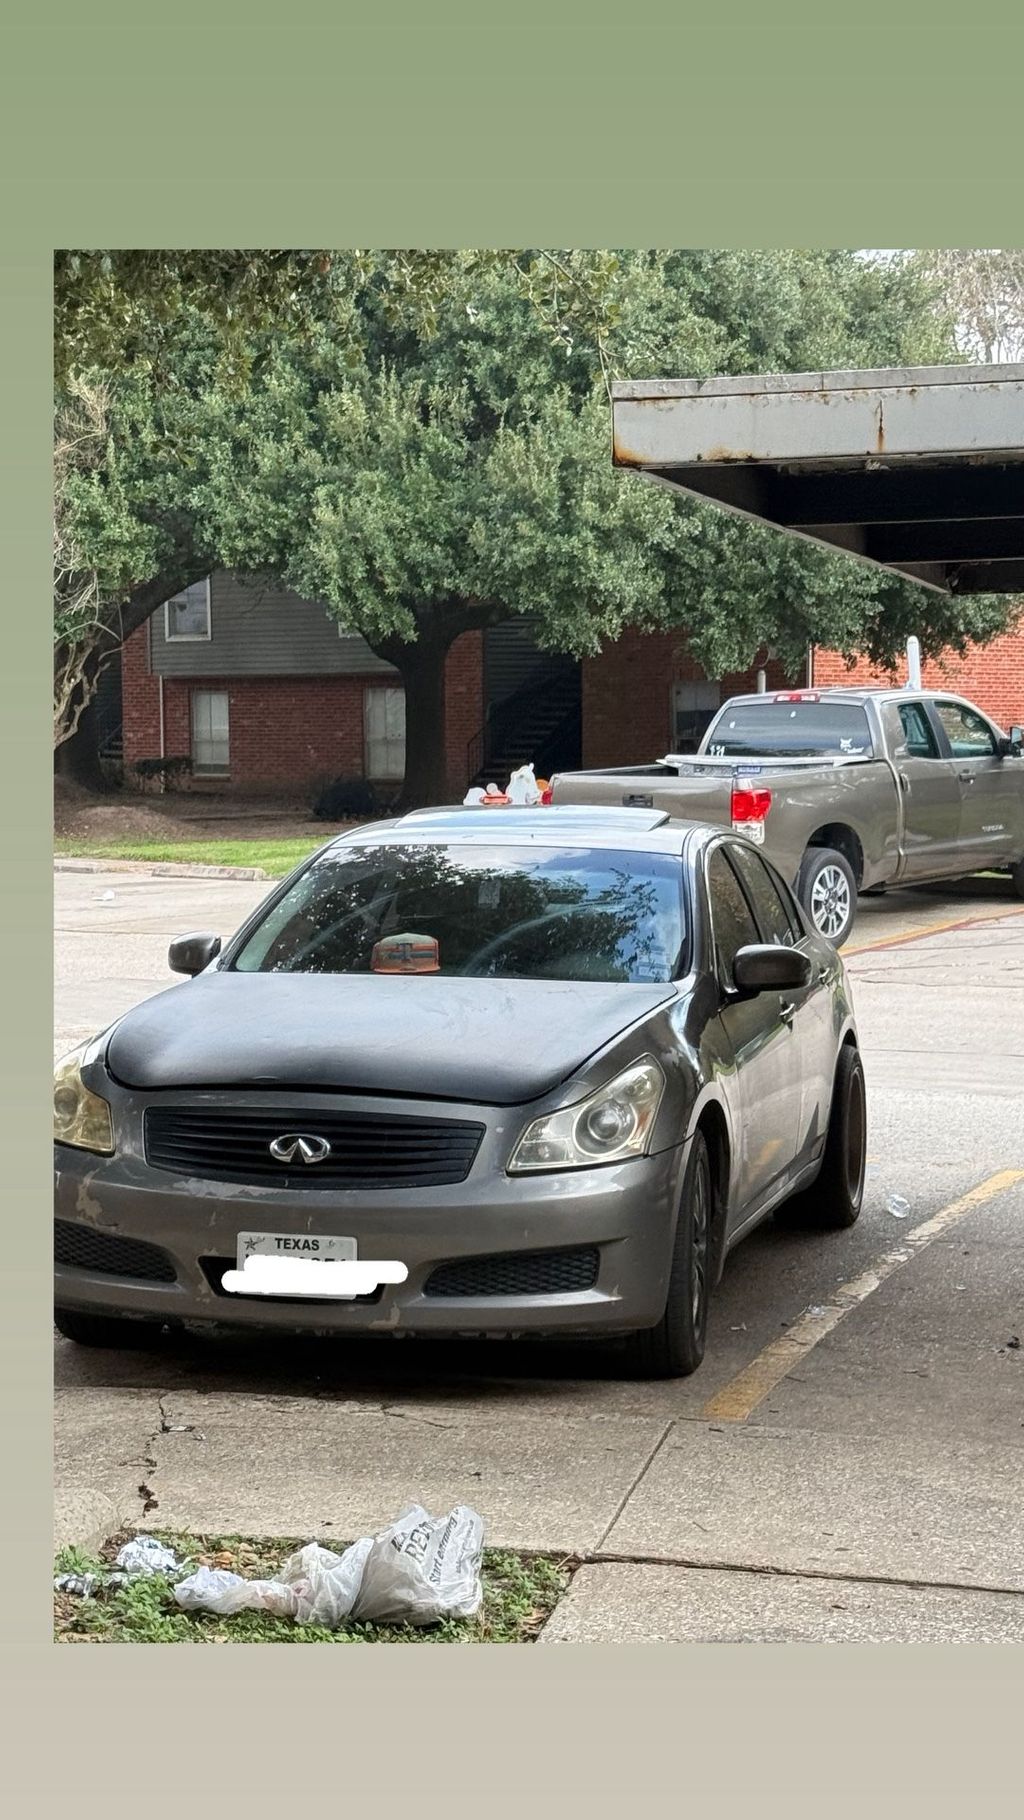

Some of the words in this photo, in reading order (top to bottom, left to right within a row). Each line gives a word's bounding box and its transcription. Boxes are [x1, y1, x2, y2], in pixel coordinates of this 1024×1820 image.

[275, 1237, 320, 1251] TEXAS
[429, 1557, 443, 1585] Start
[437, 1516, 458, 1560] earning
